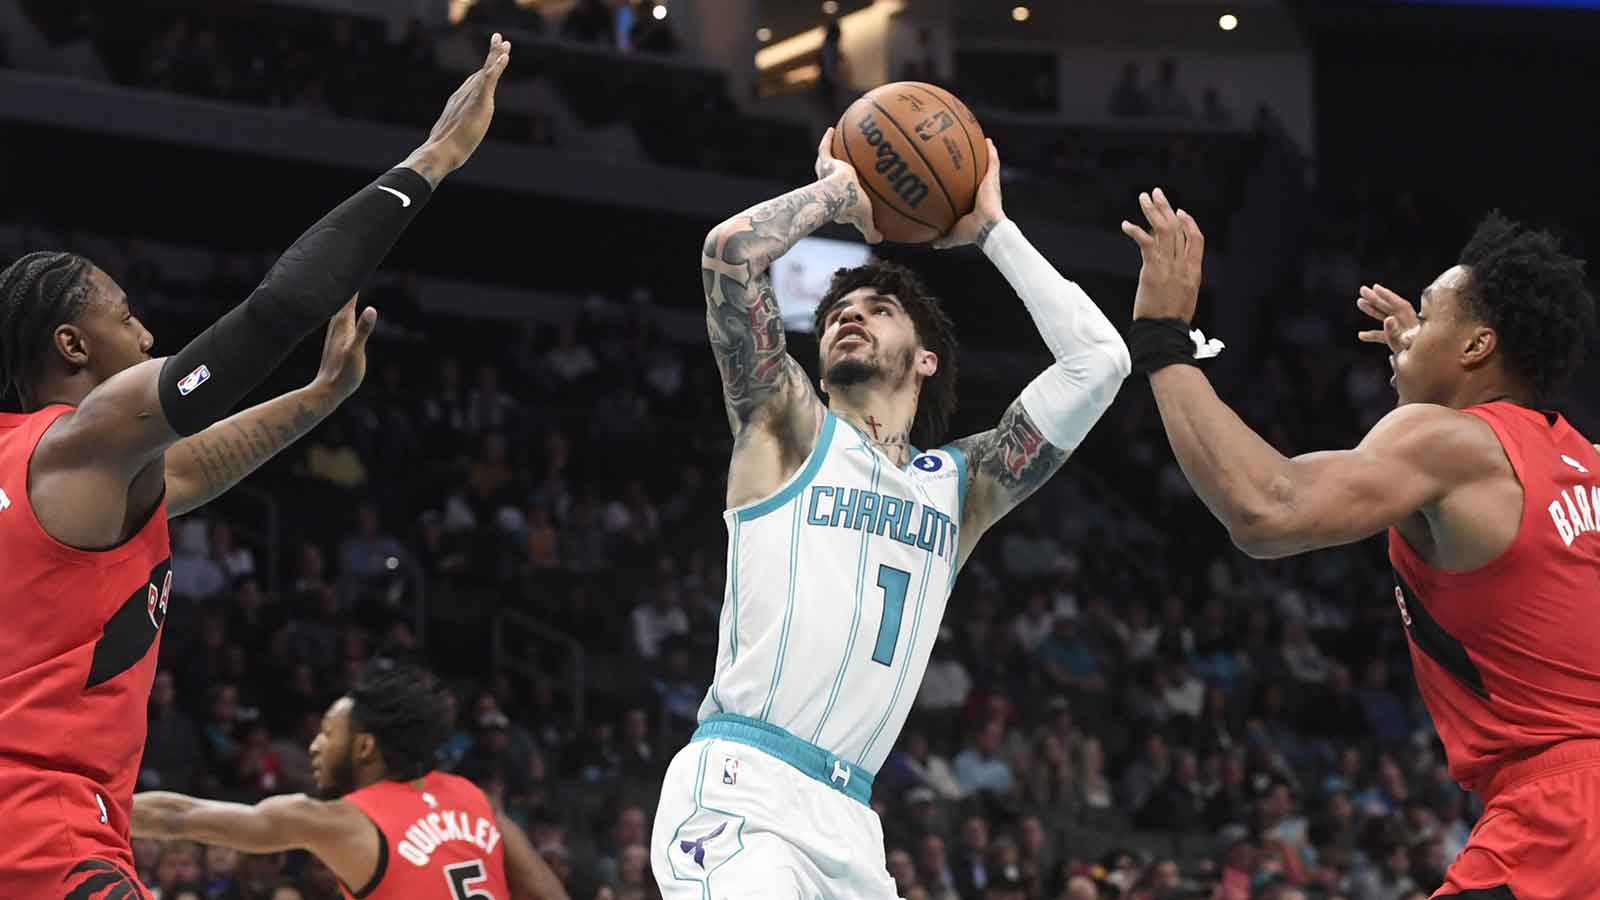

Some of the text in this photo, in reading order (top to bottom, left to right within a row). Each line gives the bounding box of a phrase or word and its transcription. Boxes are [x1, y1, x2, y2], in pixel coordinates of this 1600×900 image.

[858, 113, 929, 208] Wilson
[872, 563, 911, 667] 1
[397, 810, 500, 867] QUICKLEY
[443, 858, 497, 900] 5
